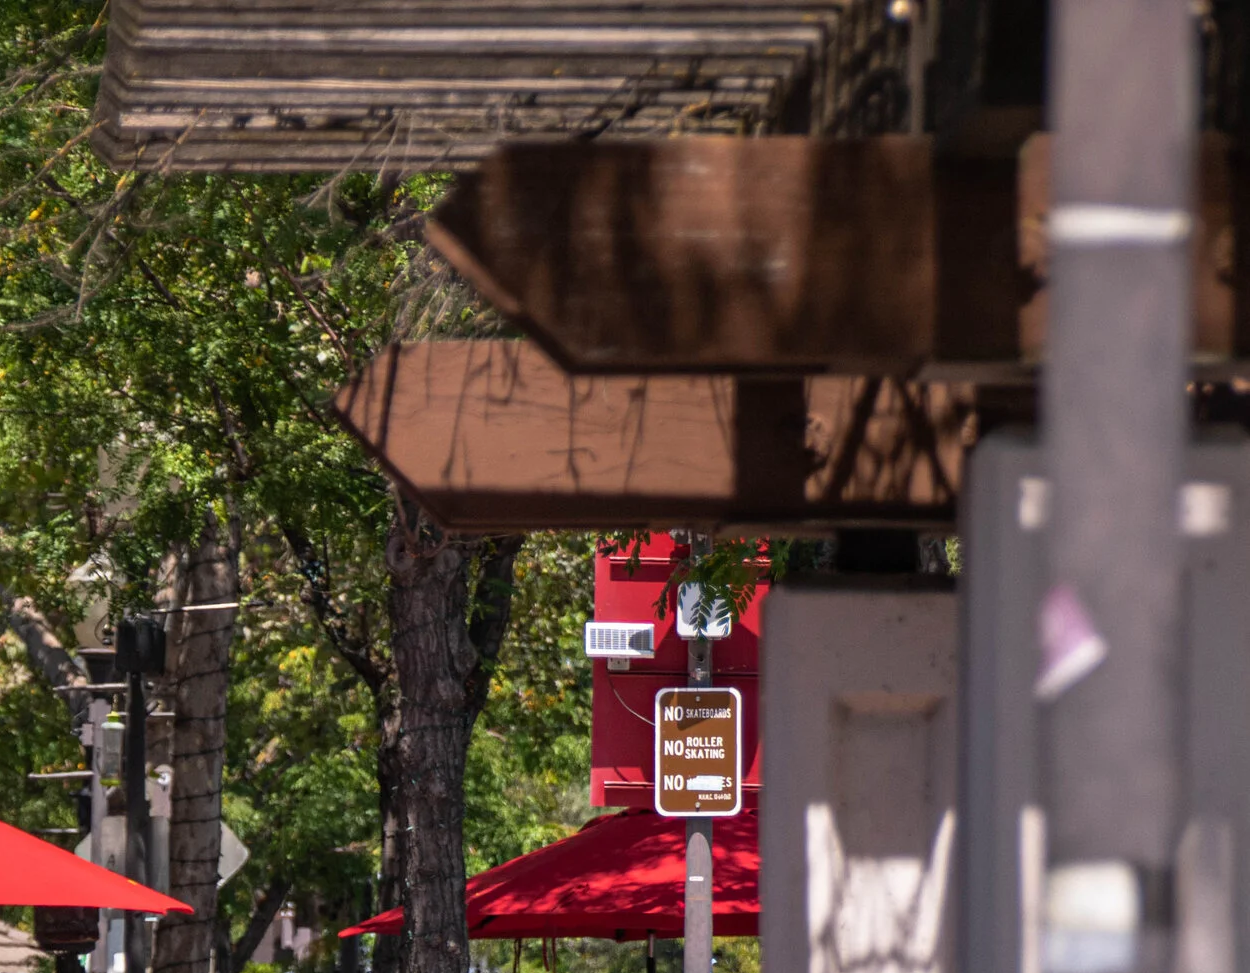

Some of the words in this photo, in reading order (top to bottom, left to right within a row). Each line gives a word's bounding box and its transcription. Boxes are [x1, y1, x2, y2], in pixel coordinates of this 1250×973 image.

[664, 706, 684, 721] NO
[685, 708, 732, 719] SKATEBOARDS
[664, 740, 684, 756] NO
[686, 736, 724, 747] ROLLER
[685, 748, 726, 759] SKATING
[663, 774, 684, 790] NO
